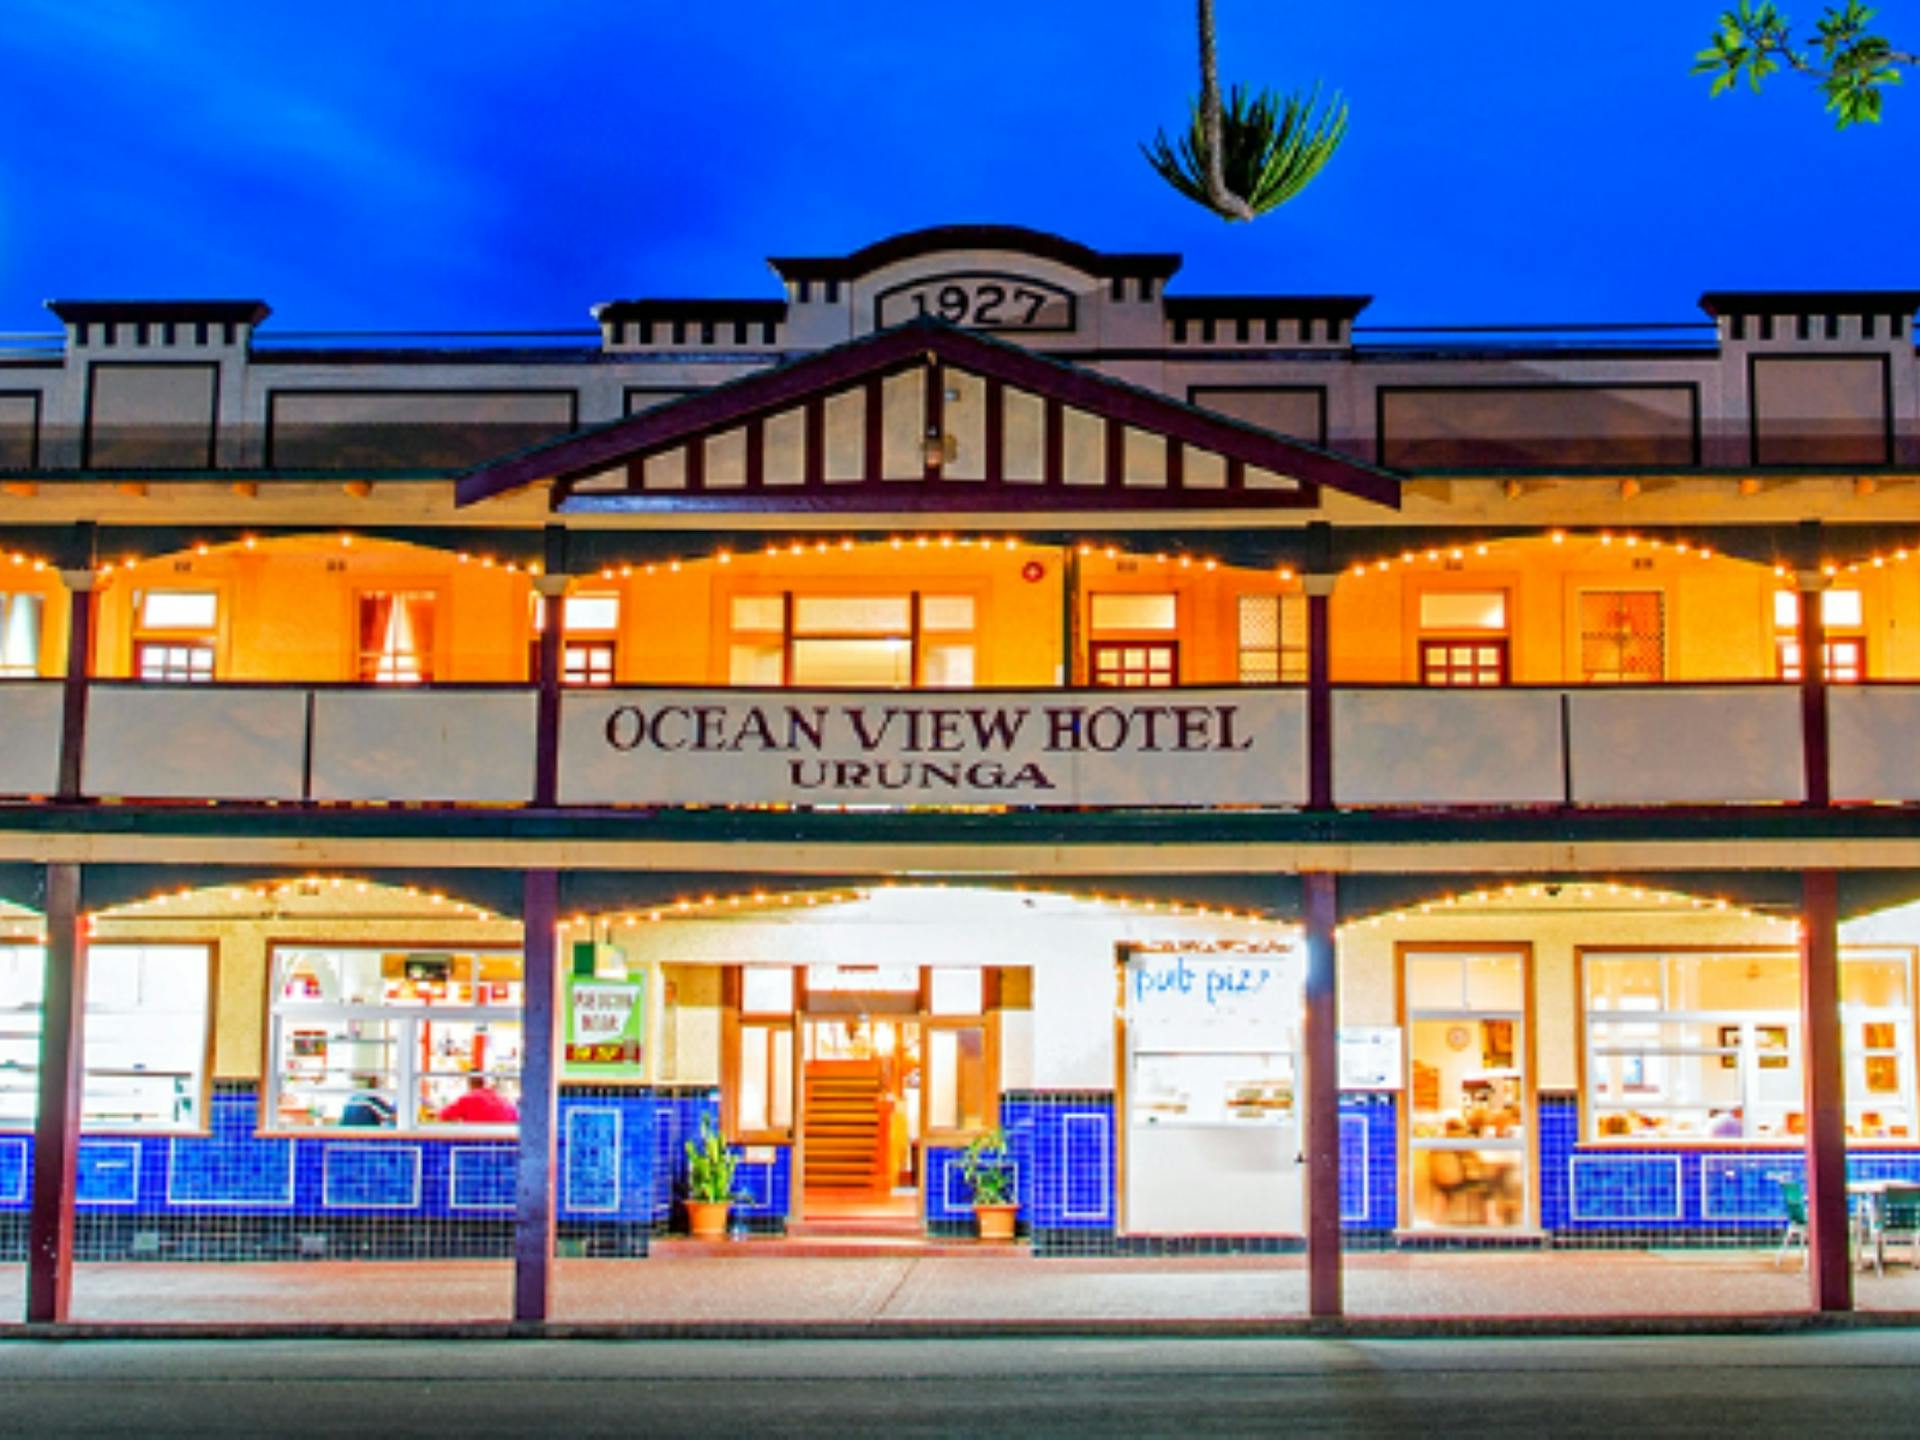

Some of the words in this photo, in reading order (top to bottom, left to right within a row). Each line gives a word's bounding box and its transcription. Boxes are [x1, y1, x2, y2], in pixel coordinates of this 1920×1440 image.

[911, 285, 1047, 324] 1927
[605, 705, 830, 752] OCEAN
[842, 706, 1030, 751] VIEW
[1043, 705, 1254, 751] HOTEL
[788, 759, 1056, 789] URUNGA
